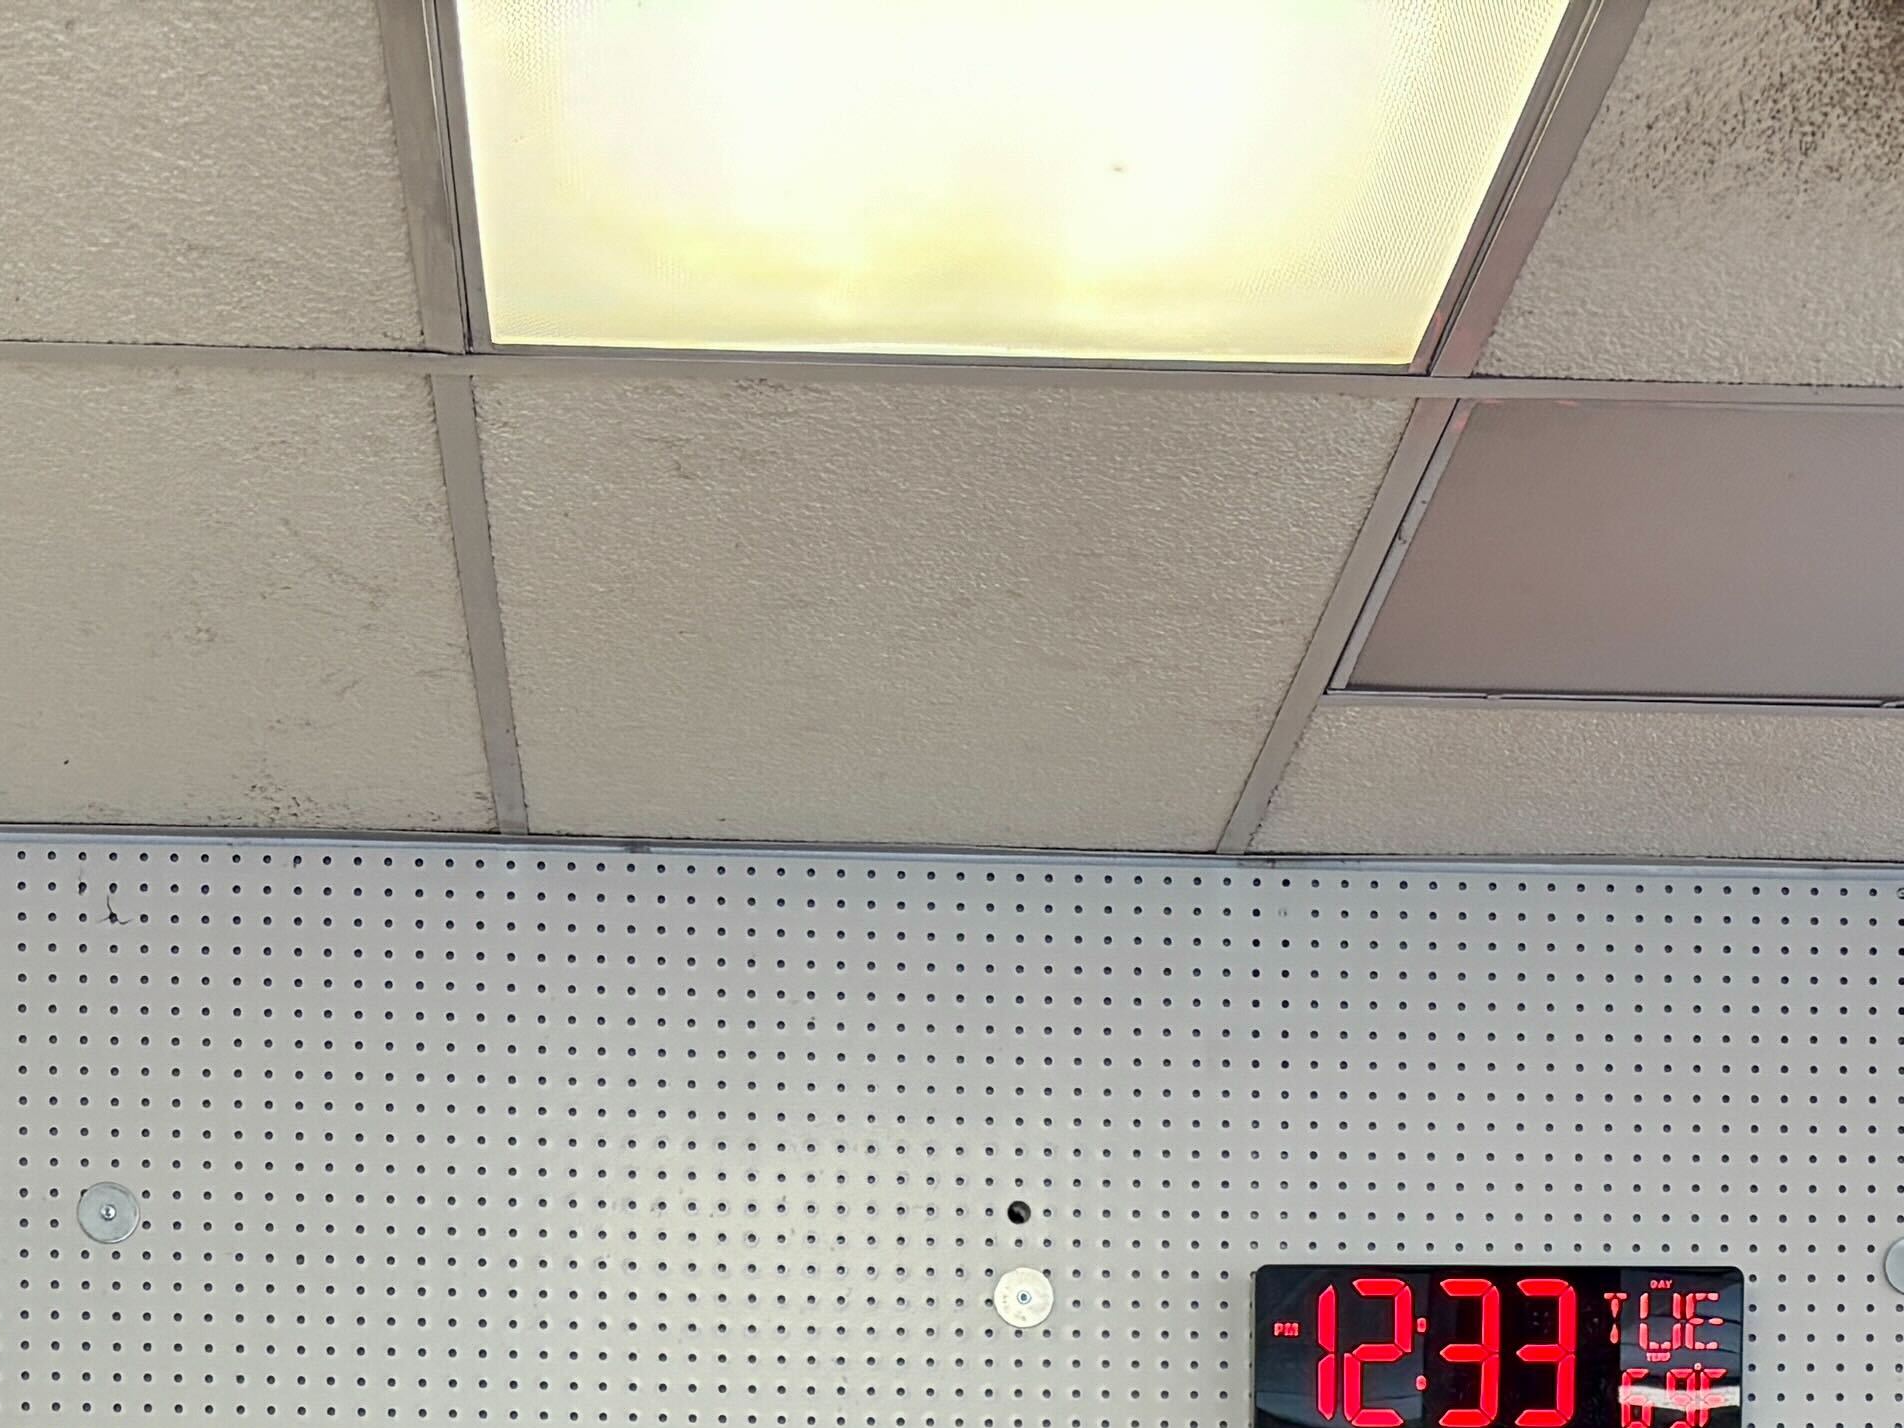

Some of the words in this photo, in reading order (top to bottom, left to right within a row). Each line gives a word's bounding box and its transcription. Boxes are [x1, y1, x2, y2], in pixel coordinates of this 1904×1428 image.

[1273, 1321, 1300, 1337] PM
[1316, 1278, 1578, 1428] 12:33
[1604, 1292, 1723, 1350] TUE
